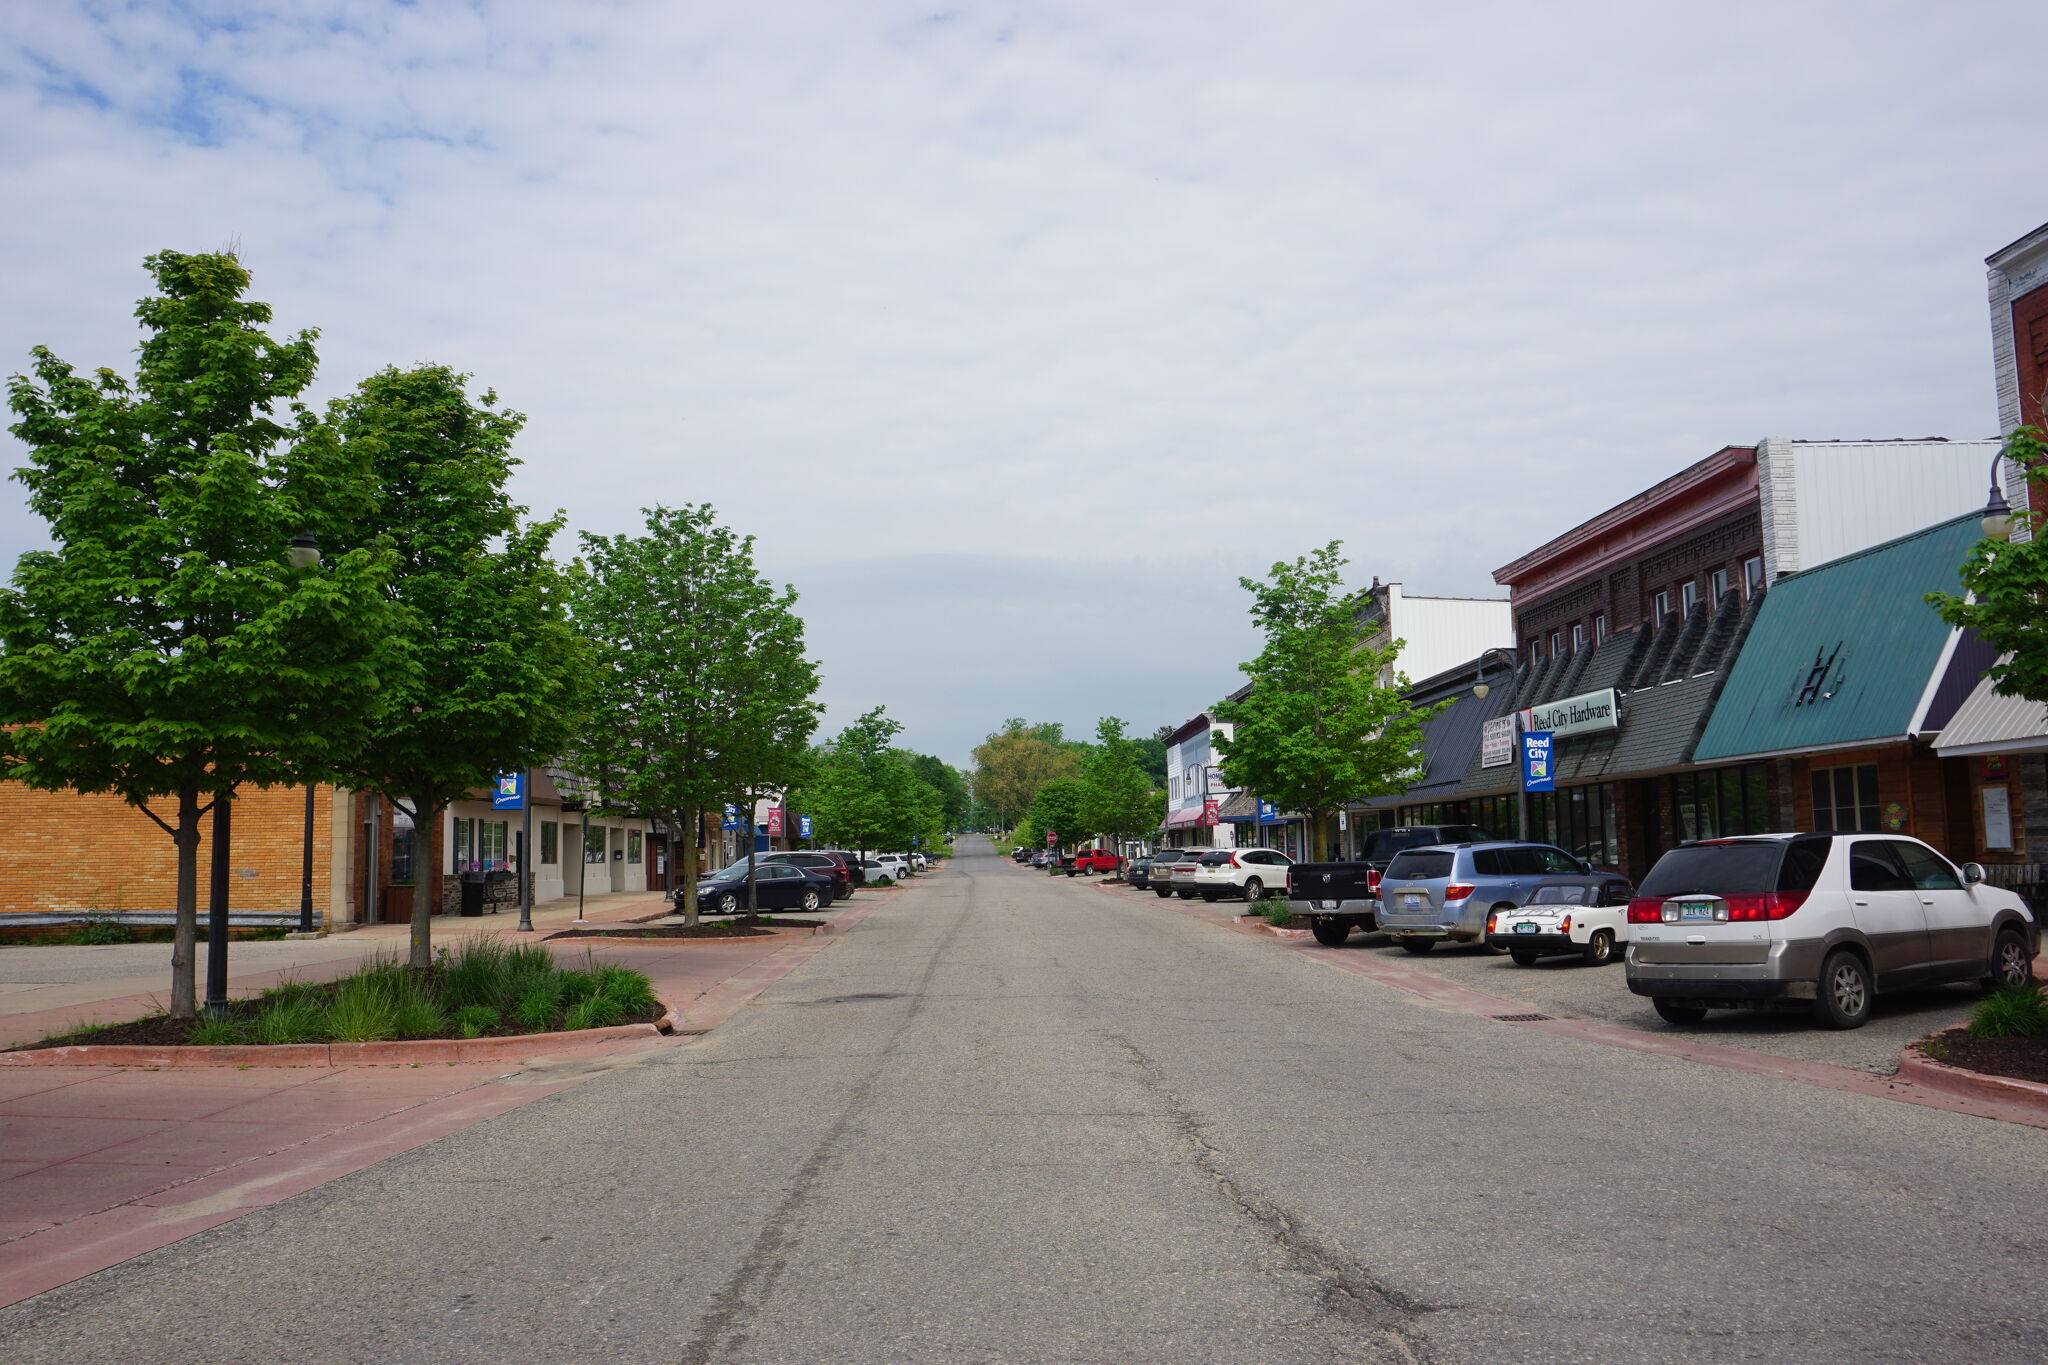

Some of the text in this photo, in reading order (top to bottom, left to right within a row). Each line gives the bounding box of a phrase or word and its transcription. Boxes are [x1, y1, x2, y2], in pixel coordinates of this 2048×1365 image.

[1534, 701, 1610, 731] Reed City Hardware
[1526, 737, 1549, 747] Reed
[1528, 748, 1548, 760] City
